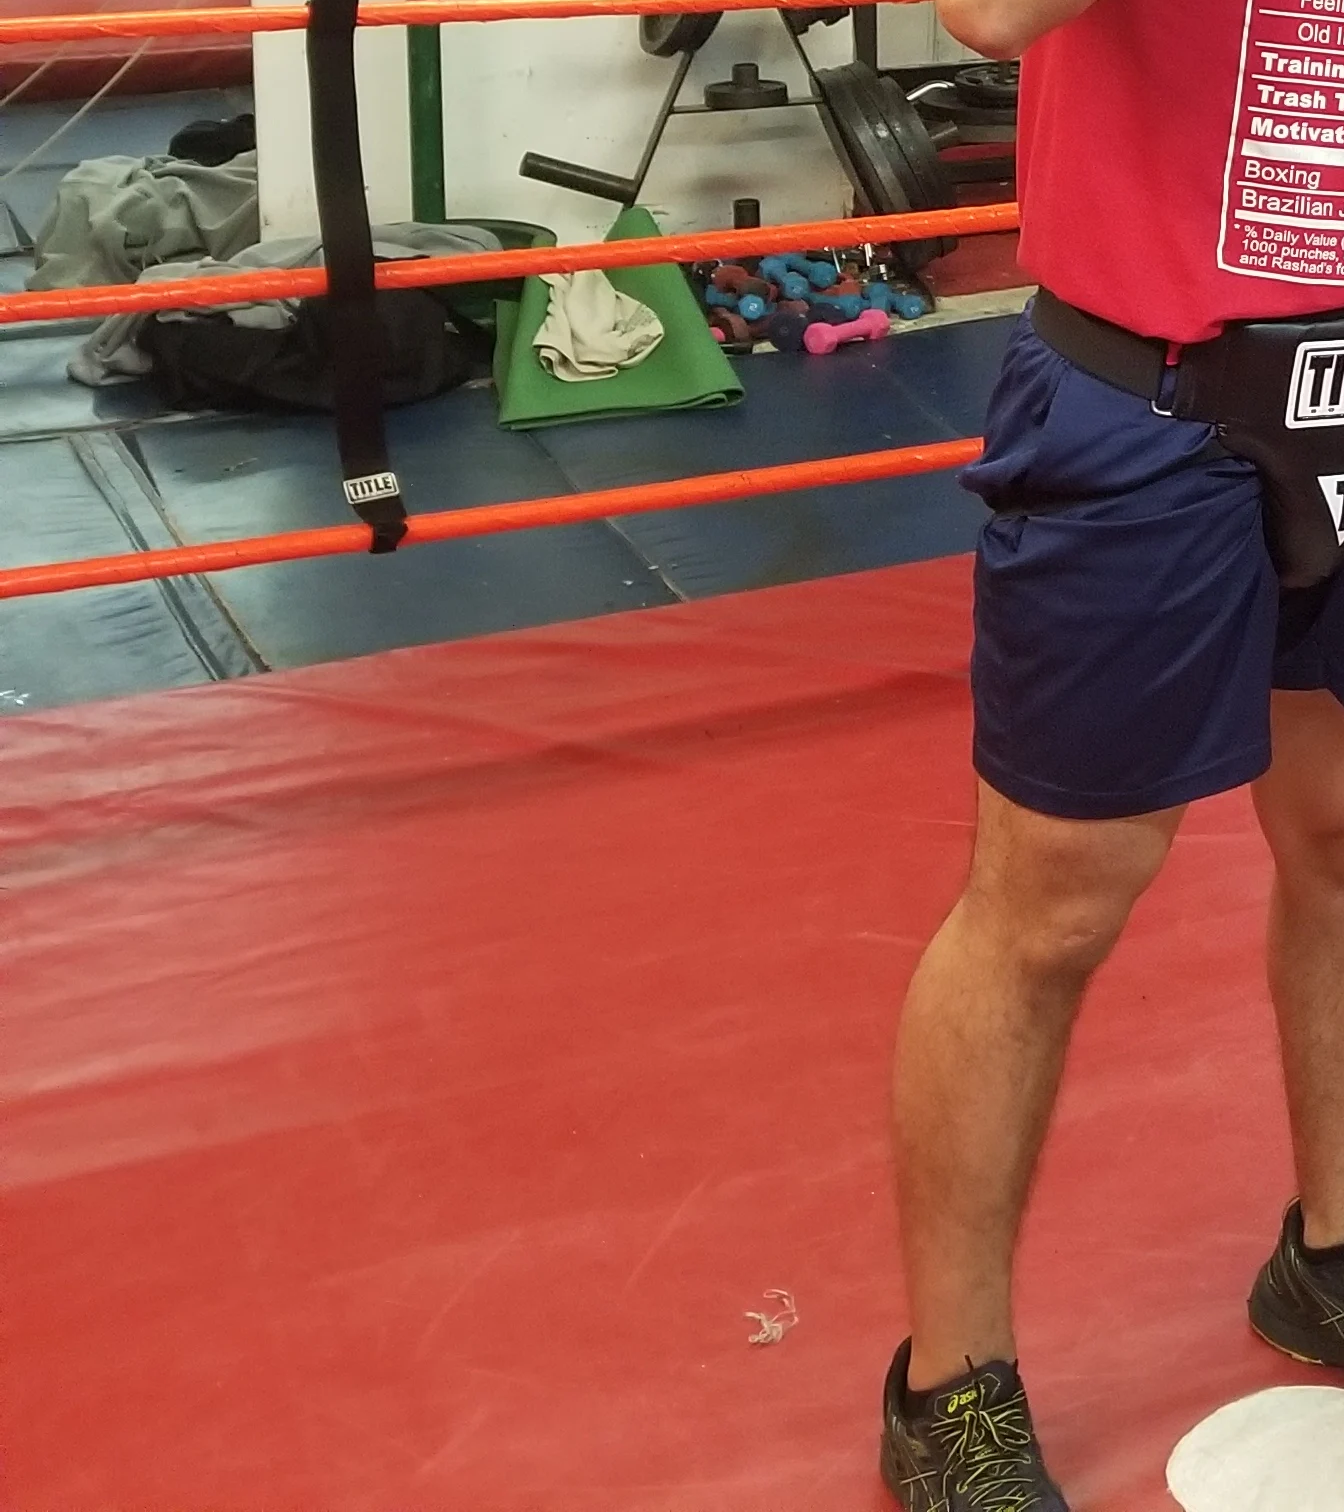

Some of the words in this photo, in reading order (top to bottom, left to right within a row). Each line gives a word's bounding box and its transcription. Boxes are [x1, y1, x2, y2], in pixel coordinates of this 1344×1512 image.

[1297, 21, 1331, 45] Old
[1258, 84, 1327, 112] Trash
[1244, 159, 1321, 190] Boxing
[1241, 189, 1333, 219] Brazilian
[1244, 225, 1258, 238] %
[1263, 227, 1300, 248] Daily
[1304, 232, 1338, 248] Value
[1241, 238, 1276, 255] 1000
[1281, 245, 1340, 263] punches,
[1238, 253, 1268, 267] and
[1271, 254, 1333, 274] Rashad's
[349, 475, 393, 497] TITLE
